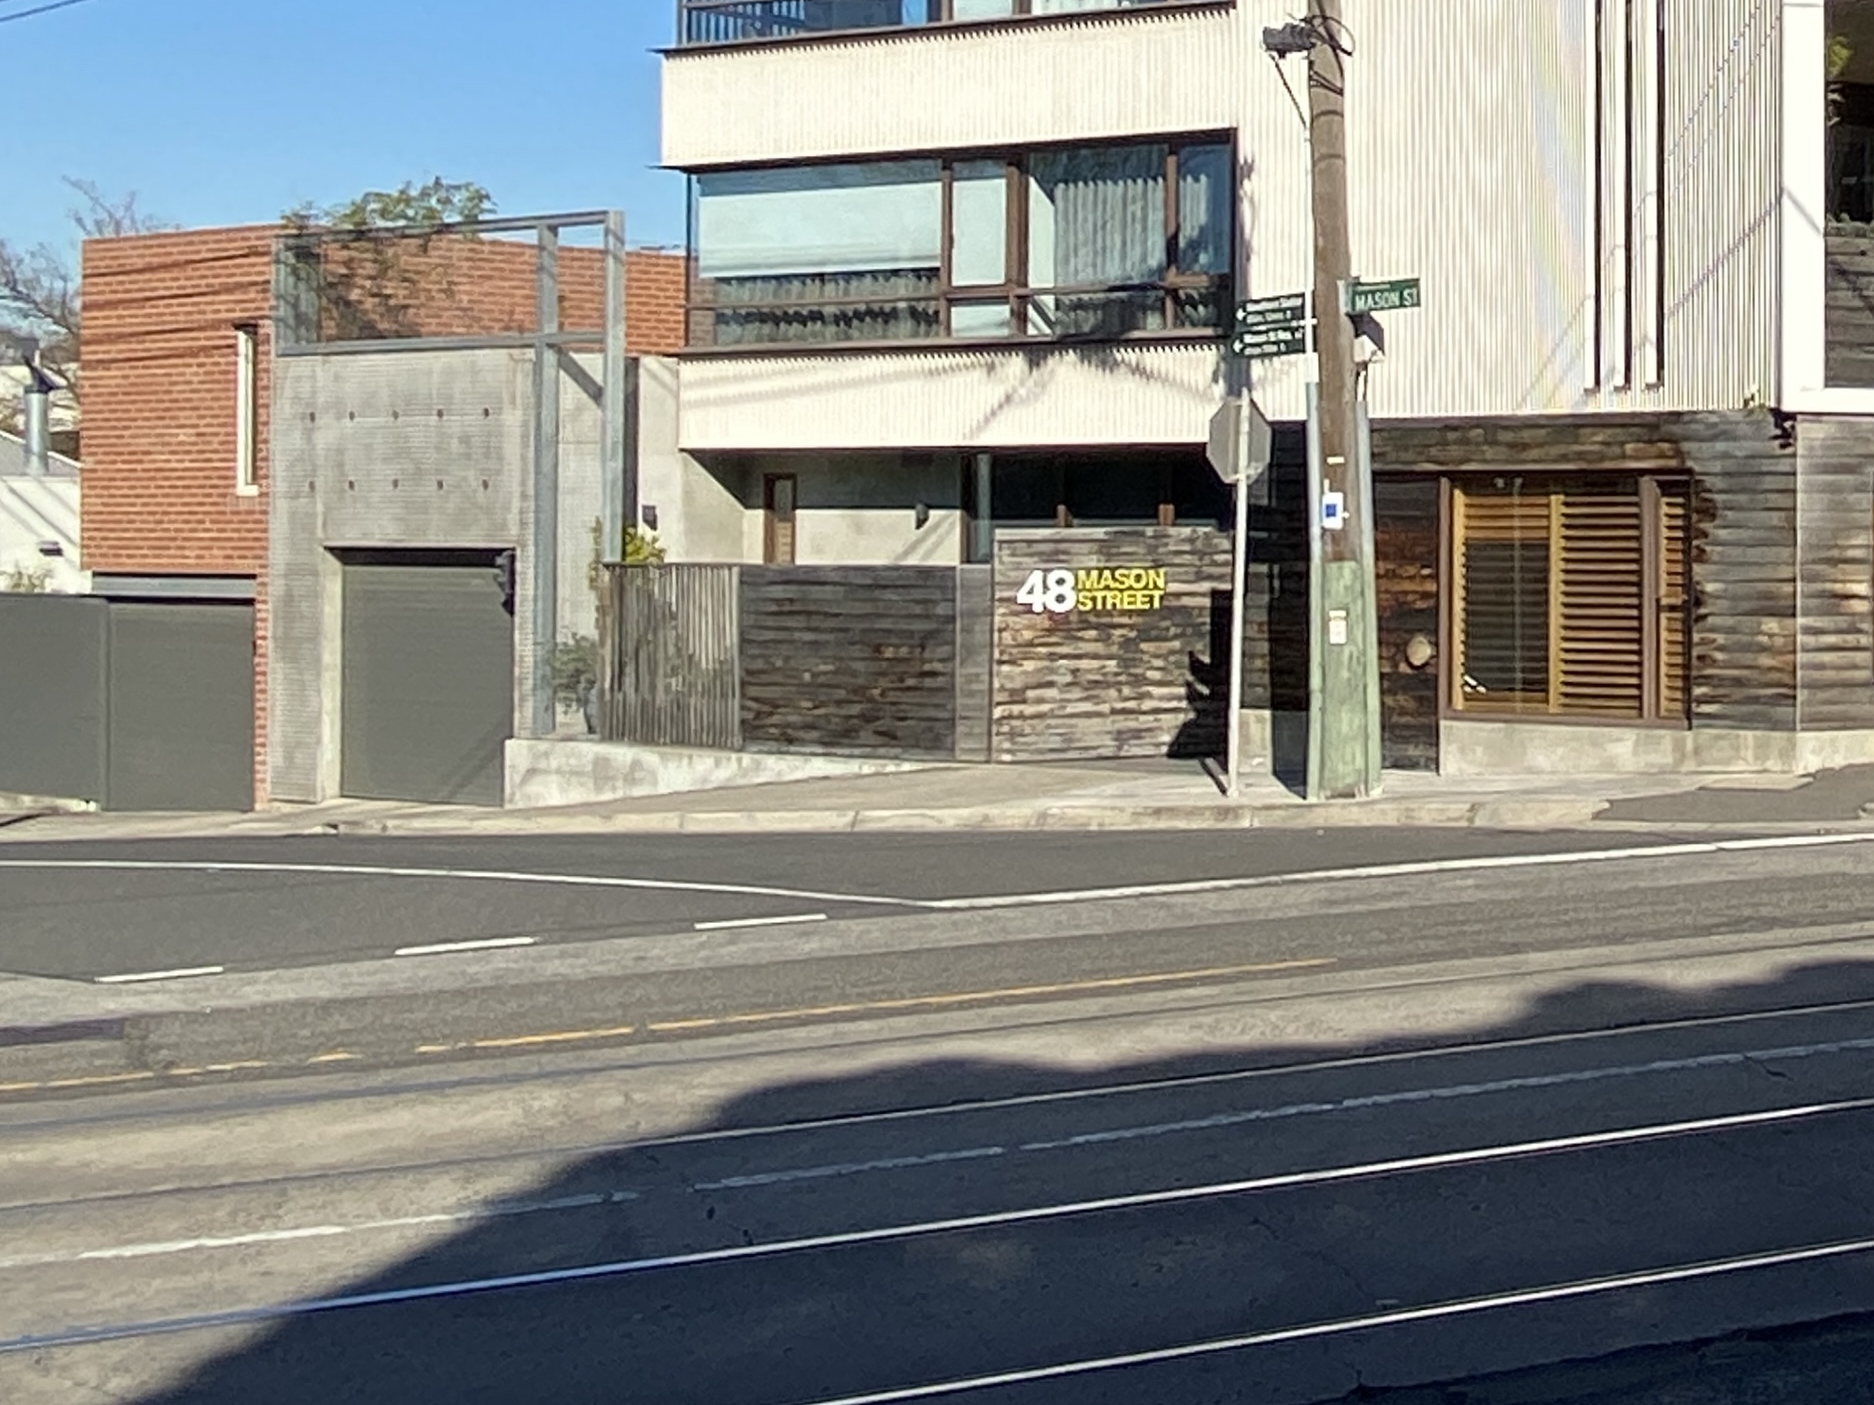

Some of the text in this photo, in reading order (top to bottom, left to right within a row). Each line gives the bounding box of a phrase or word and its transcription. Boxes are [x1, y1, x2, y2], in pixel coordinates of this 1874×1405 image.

[1355, 287, 1418, 311] MASON ST
[1077, 568, 1166, 589] MASON
[1017, 569, 1077, 613] 48
[1077, 589, 1165, 612] STREET
